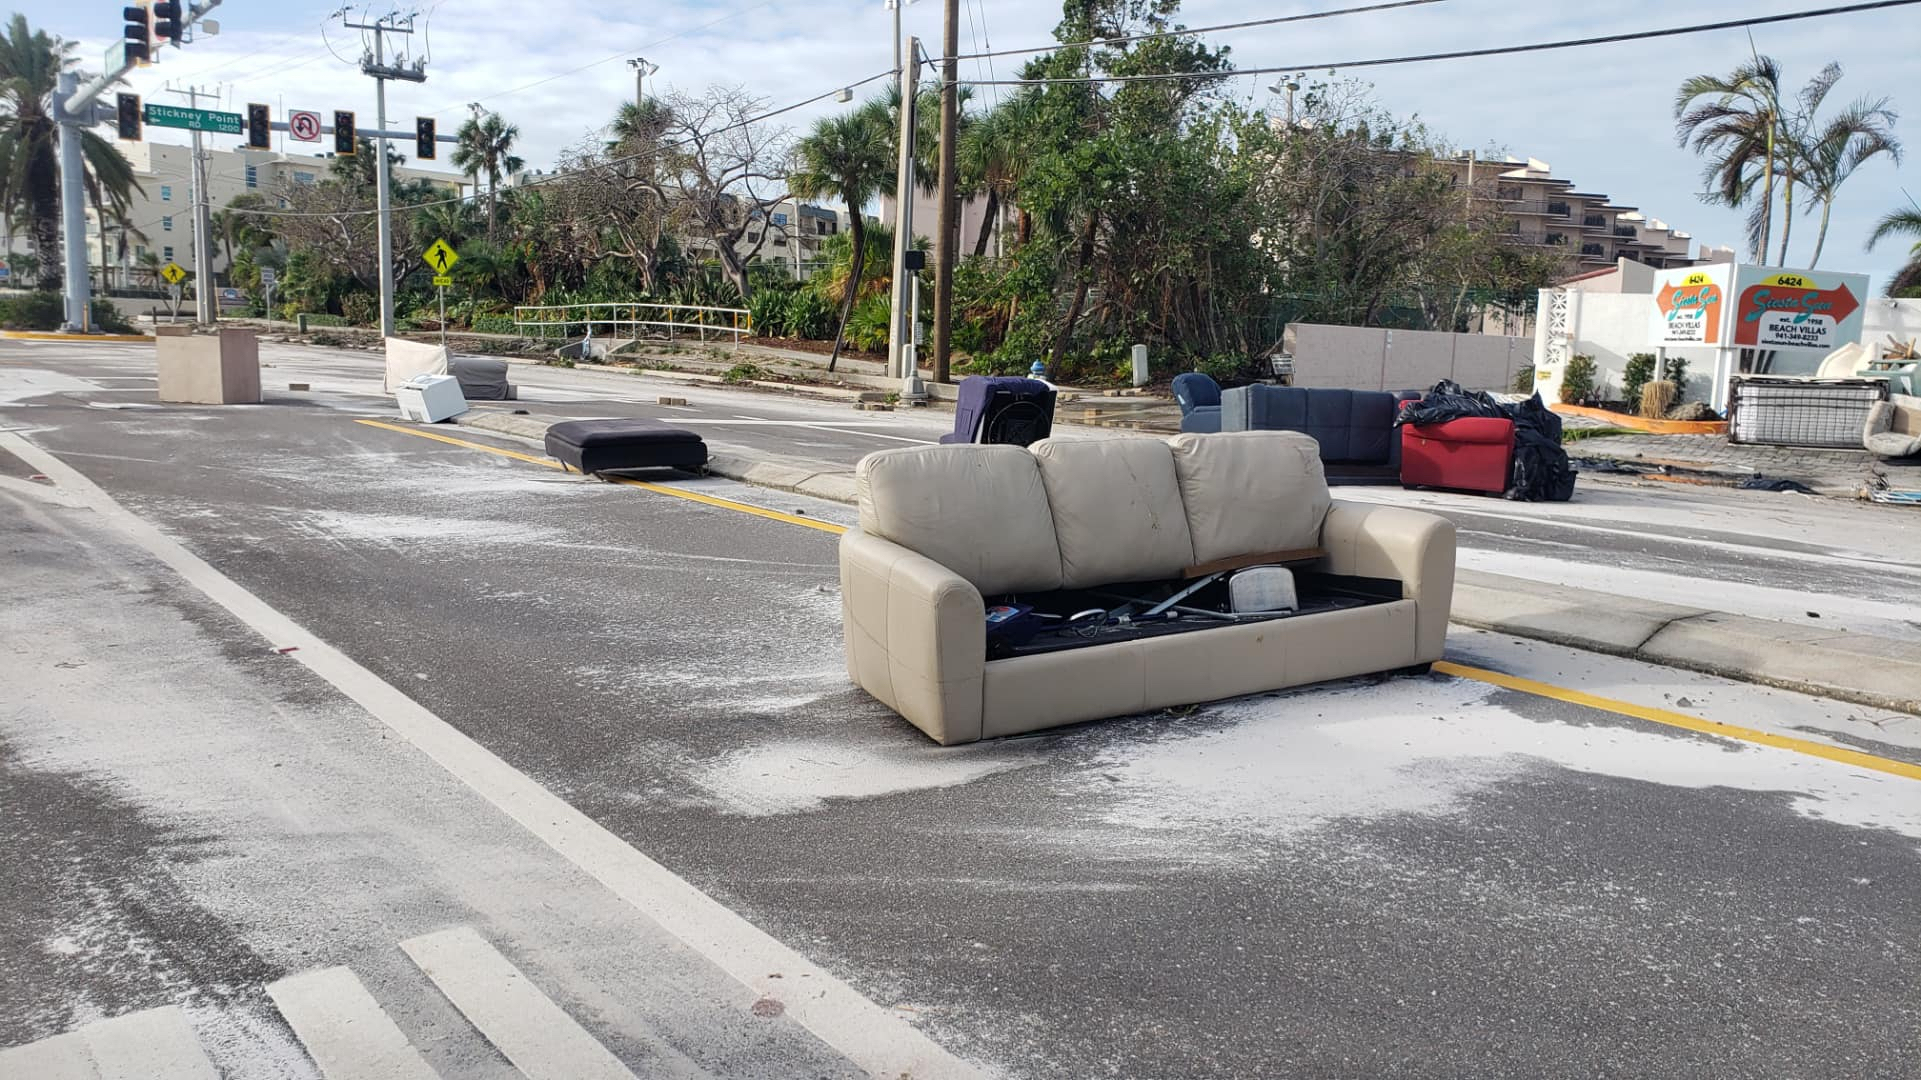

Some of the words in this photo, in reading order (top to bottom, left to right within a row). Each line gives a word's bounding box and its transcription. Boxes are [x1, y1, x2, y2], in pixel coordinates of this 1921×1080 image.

[148, 107, 202, 120] Stickney
[208, 113, 239, 124] Point
[218, 124, 239, 132] 1200
[1777, 276, 1803, 287] 6424
[1745, 289, 1799, 322] Siesta
[1793, 292, 1834, 324] Sun
[1769, 324, 1797, 332] BEACH
[1799, 325, 1827, 335] VILLAS
